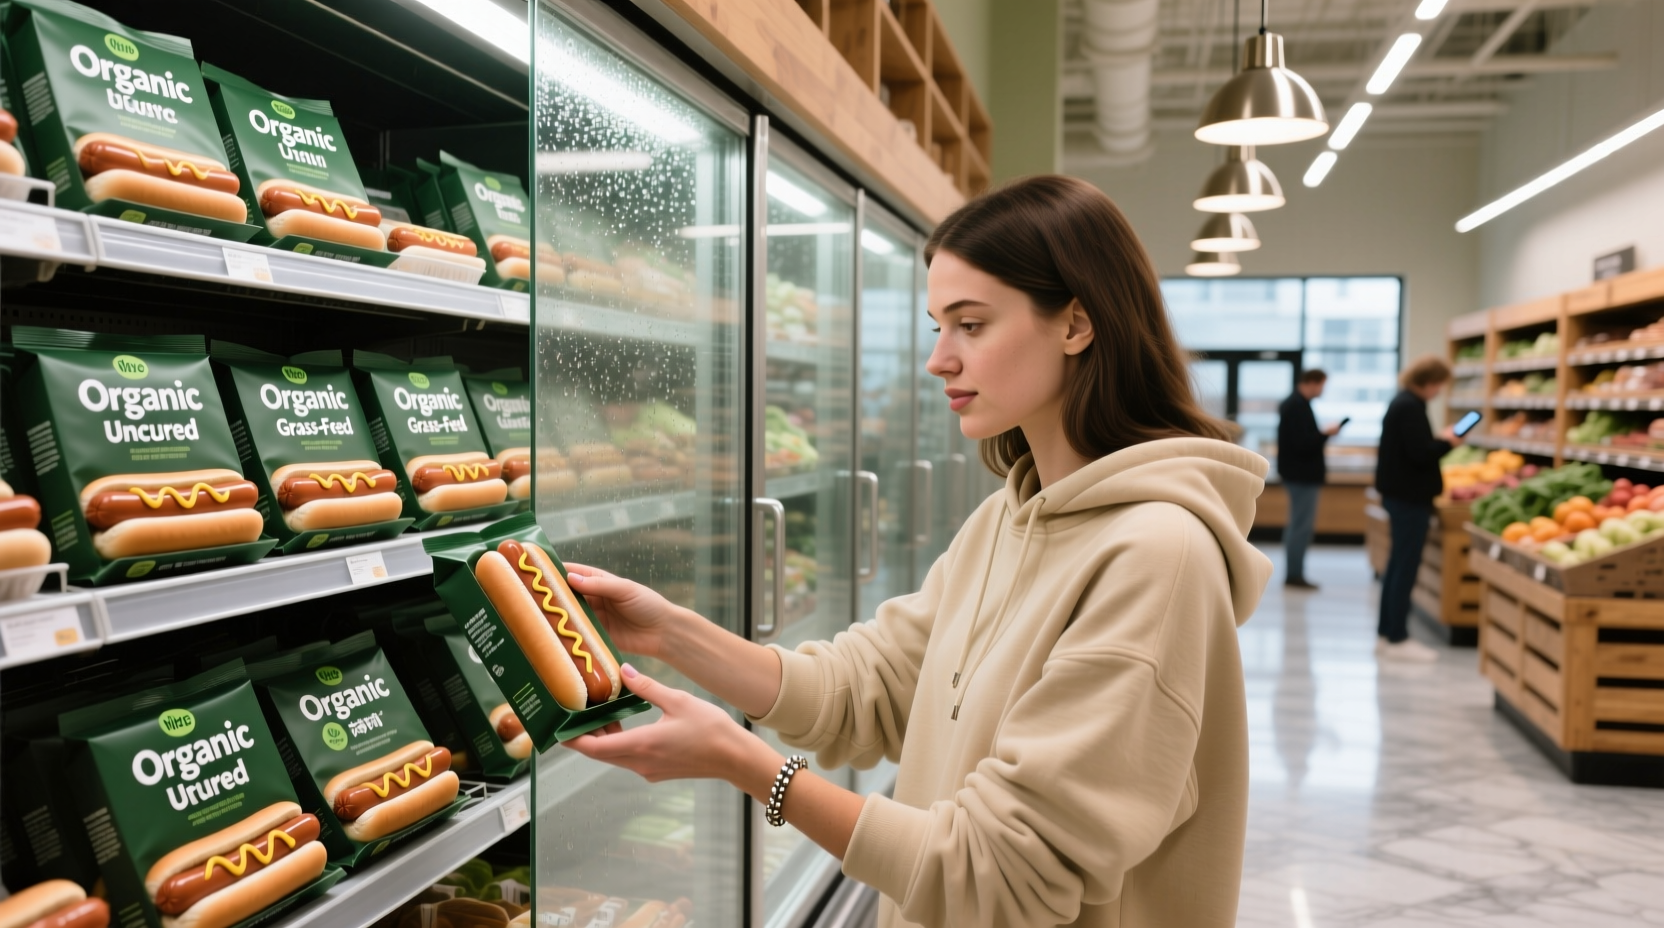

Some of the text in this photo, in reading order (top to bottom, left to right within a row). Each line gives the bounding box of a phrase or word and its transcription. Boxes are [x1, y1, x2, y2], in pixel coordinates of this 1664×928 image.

[69, 44, 193, 104] Organic
[248, 109, 337, 152] Organic
[78, 379, 203, 420] Organic
[260, 383, 349, 417] Organic
[393, 386, 463, 417] Organic
[103, 417, 199, 444] Uncured
[299, 672, 390, 722] Organic
[131, 719, 255, 786] Organic
